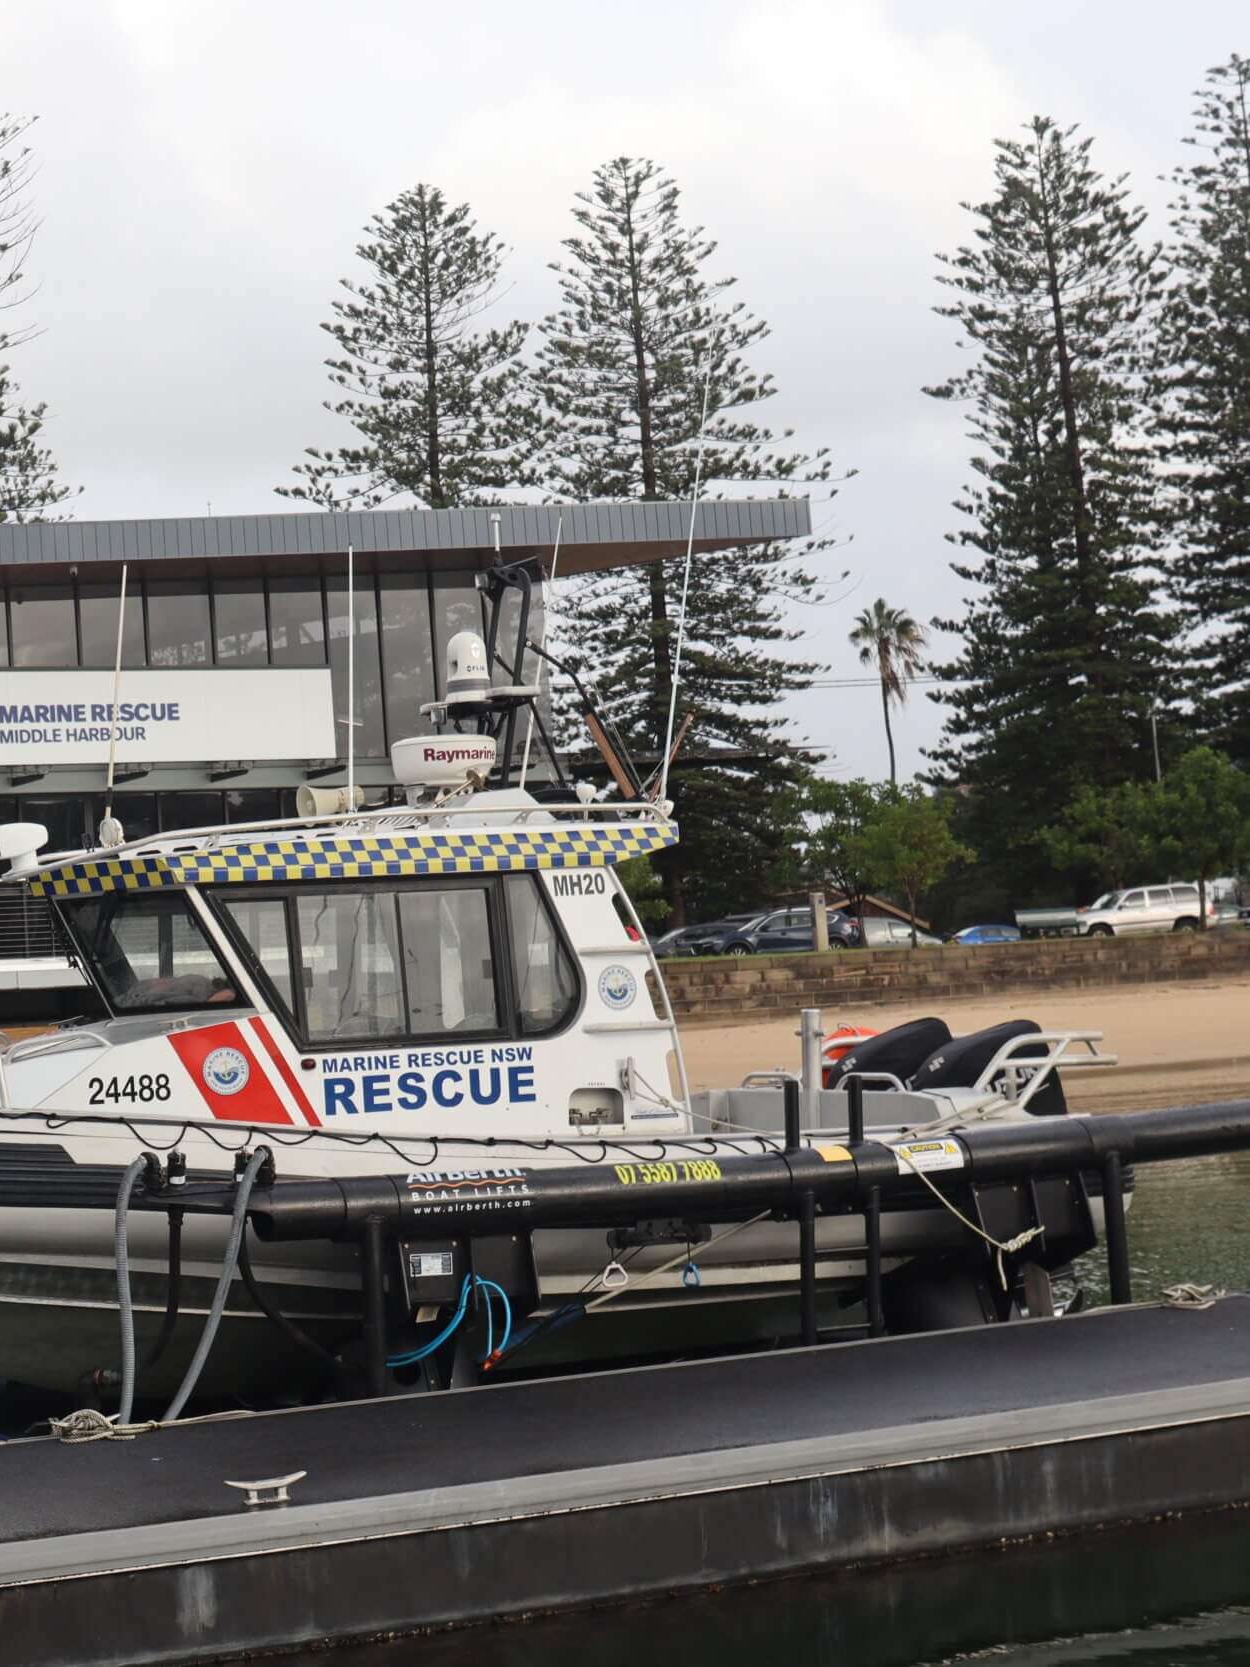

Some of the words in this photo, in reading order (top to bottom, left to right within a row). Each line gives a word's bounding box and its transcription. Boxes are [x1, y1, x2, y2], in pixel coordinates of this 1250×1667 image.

[90, 702, 180, 722] RESCUE
[0, 727, 62, 744] MIDDLE
[66, 725, 146, 742] HARBOUR
[423, 746, 495, 763] Raymarine
[553, 873, 606, 897] MH20
[322, 1055, 401, 1073] MARINE
[407, 1049, 484, 1068] RESCUE
[491, 1046, 533, 1063] NSW
[88, 1073, 172, 1105] 24488
[324, 1065, 537, 1116] RESCUE
[614, 1164, 636, 1185] 07
[637, 1162, 678, 1184] 5587
[676, 1160, 721, 1182] 7888
[411, 1189, 461, 1201] BOAT
[474, 1184, 530, 1198] LIFTS
[413, 1199, 531, 1215] www.airberth.com
